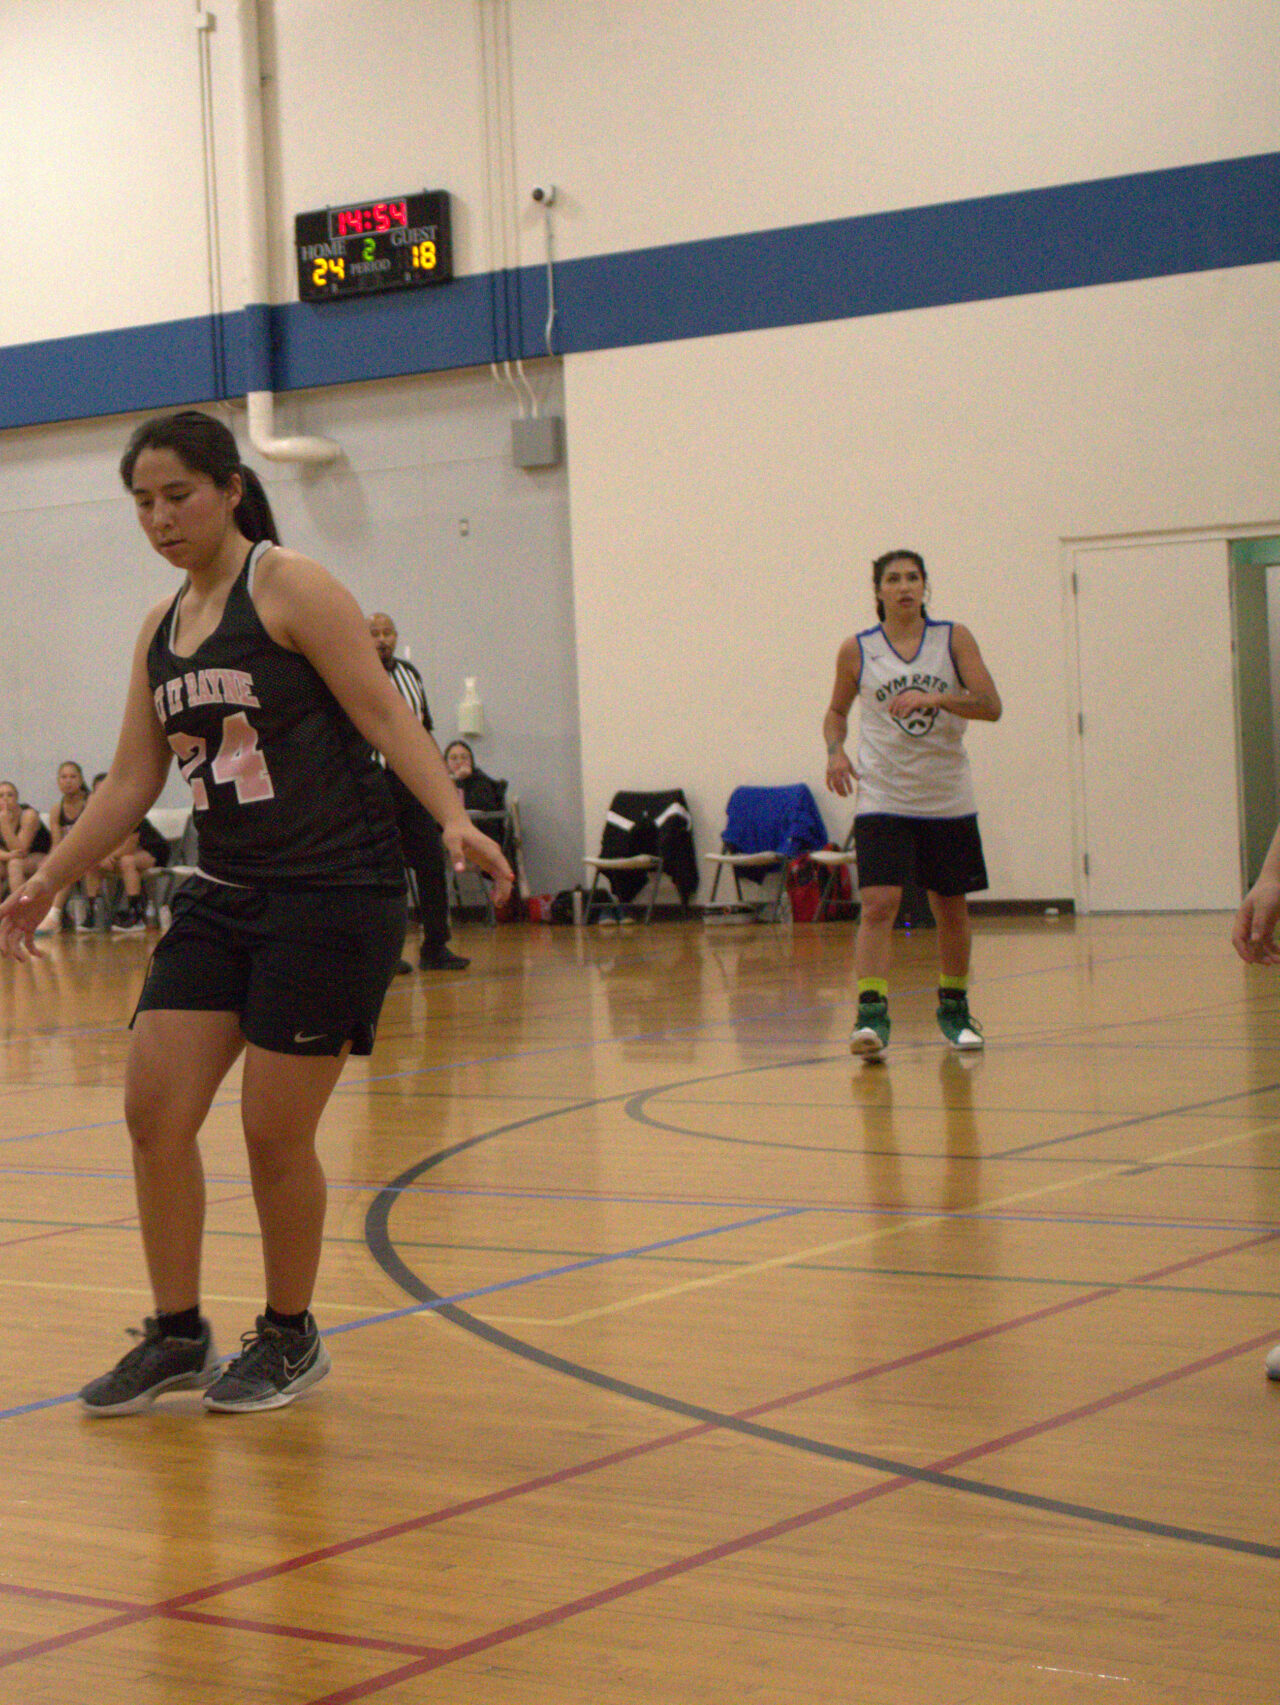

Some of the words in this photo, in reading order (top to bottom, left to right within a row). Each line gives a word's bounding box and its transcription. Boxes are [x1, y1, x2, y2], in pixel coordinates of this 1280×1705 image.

[338, 202, 407, 236] 14:54
[390, 225, 438, 246] GUEST
[301, 240, 346, 262] HOME
[362, 238, 376, 262] 2
[412, 241, 437, 270] 18
[312, 258, 345, 286] 24
[350, 258, 392, 276] PERIOD
[912, 673, 948, 693] RATS
[167, 711, 275, 811] 24
